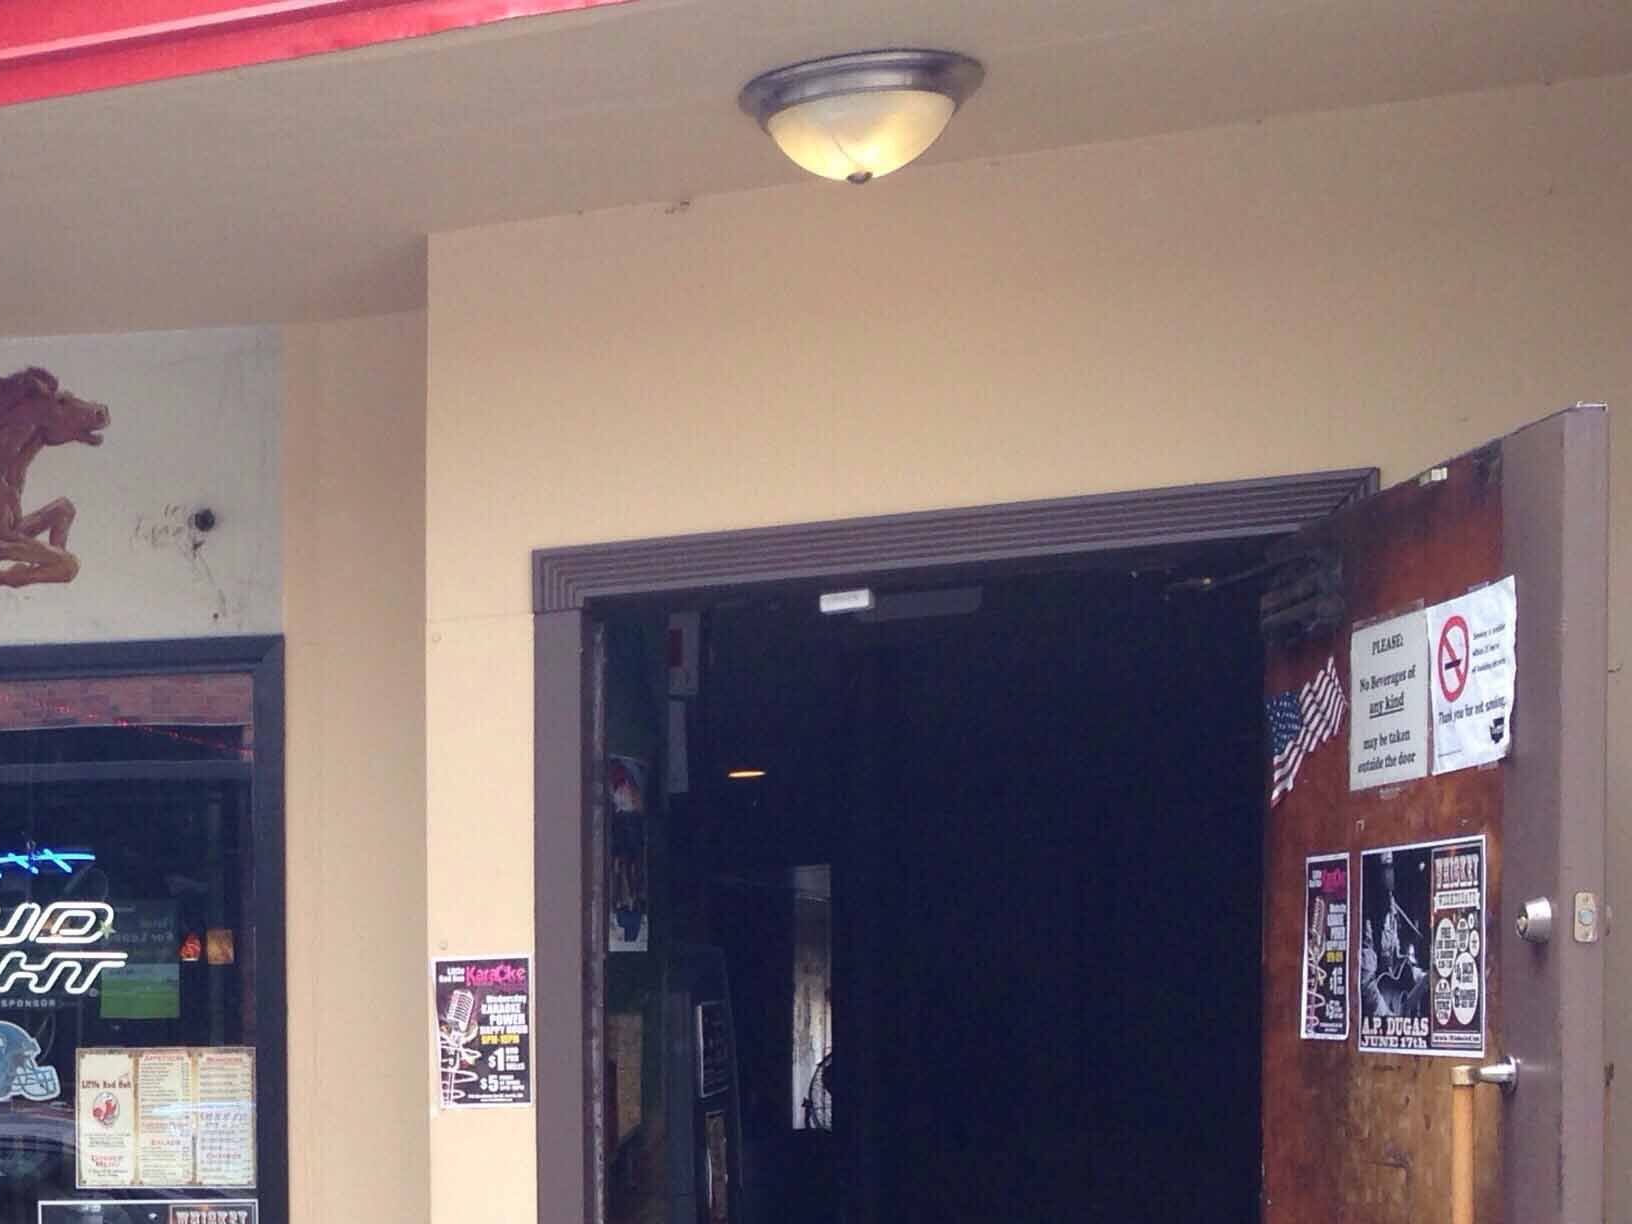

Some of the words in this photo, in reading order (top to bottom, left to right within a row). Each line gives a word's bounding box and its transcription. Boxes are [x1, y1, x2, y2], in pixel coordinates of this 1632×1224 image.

[1360, 677, 1369, 692] No
[1371, 670, 1406, 690] Beverages
[1408, 665, 1416, 679] of
[1369, 700, 1384, 716] any
[1385, 691, 1405, 710] kind
[1363, 736, 1378, 751] may
[1379, 732, 1388, 746] be
[1389, 728, 1410, 744] taken
[1358, 755, 1384, 773] outside
[1385, 752, 1397, 767] the
[1399, 751, 1416, 765] door
[1, 999, 56, 1008] SPONSOR
[1362, 1016, 1383, 1034] A.P.
[1386, 1017, 1428, 1036] DUGAS
[1361, 1036, 1398, 1047] JUNE
[1400, 1037, 1427, 1049] 17th
